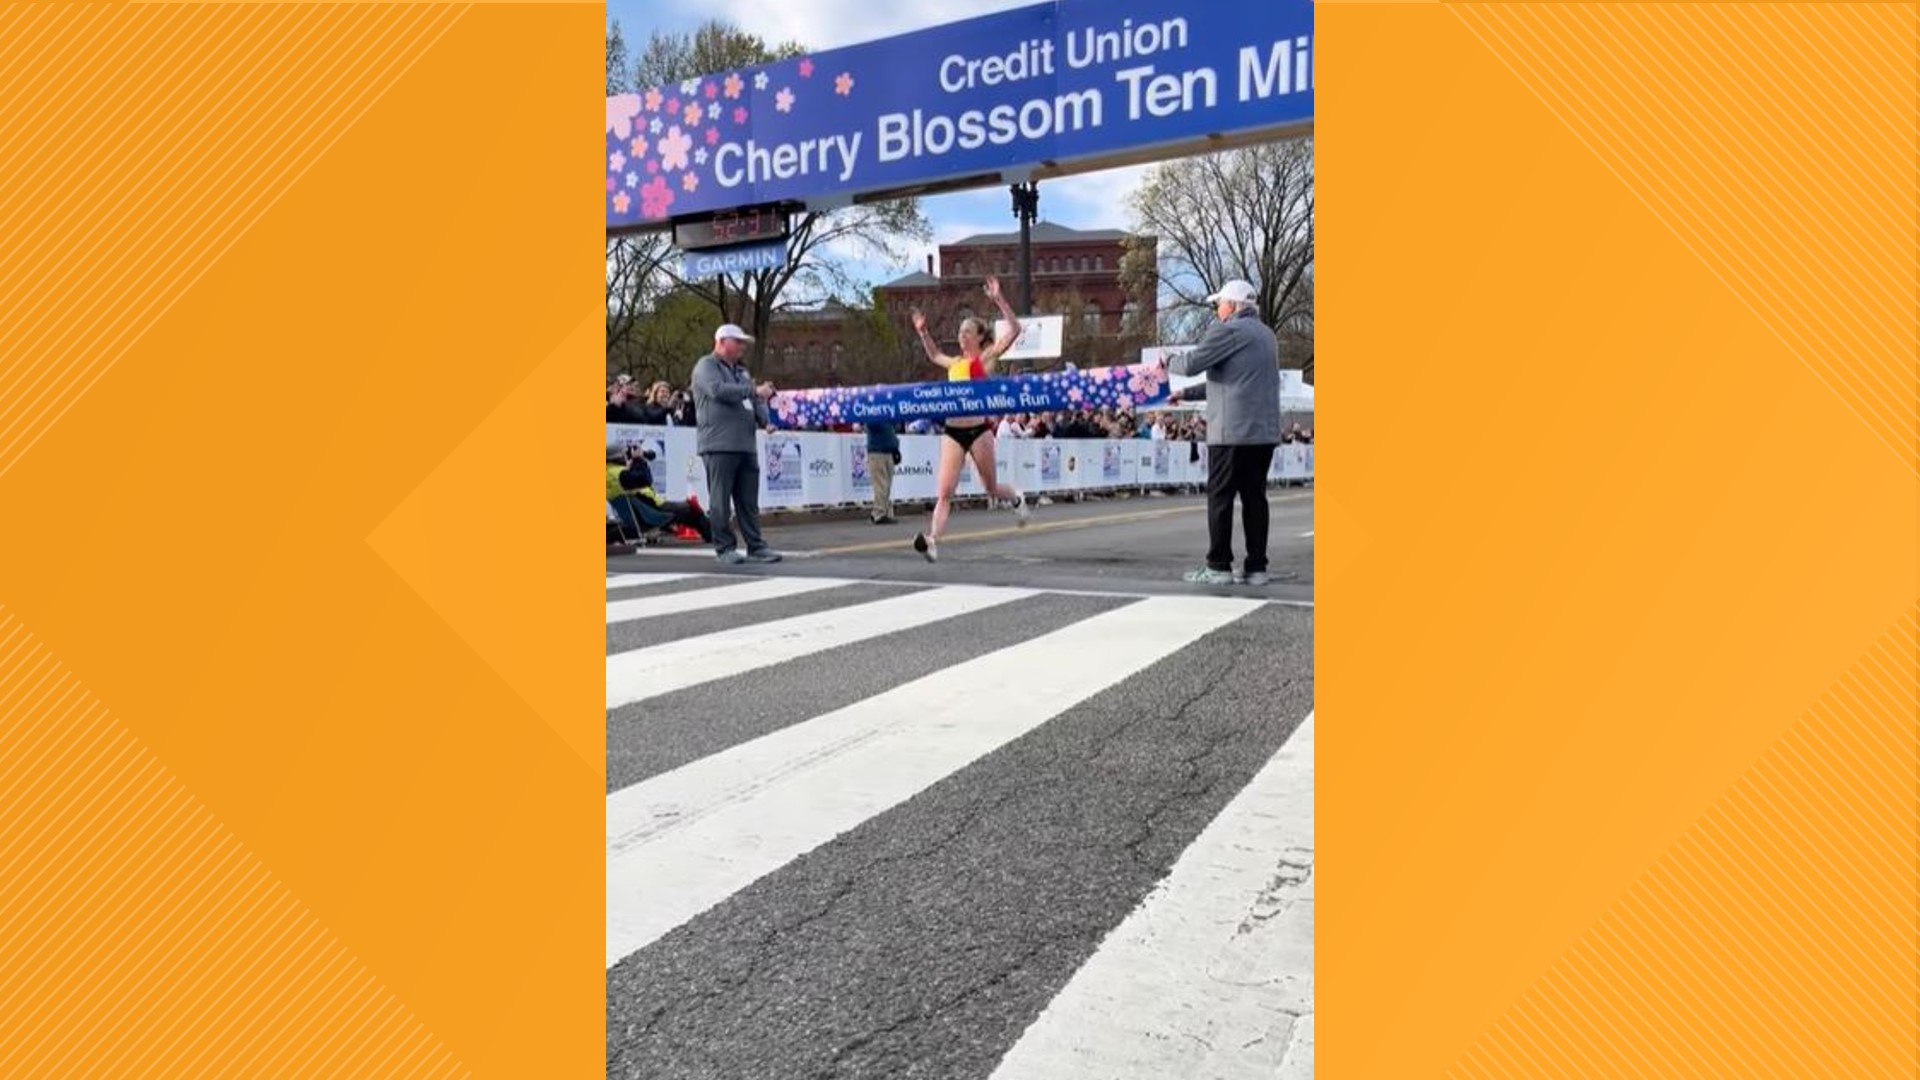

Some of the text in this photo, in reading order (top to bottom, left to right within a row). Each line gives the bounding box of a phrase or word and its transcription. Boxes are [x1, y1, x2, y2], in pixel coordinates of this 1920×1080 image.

[939, 17, 1188, 93] Credit Union
[714, 35, 1314, 188] Cherry Blossom Ten Mi
[697, 247, 777, 273] GARMIN
[853, 391, 1050, 417] Cherry Blossom Ten Mile Run
[913, 385, 974, 398] Credit Union
[892, 465, 933, 475] ARMIN
